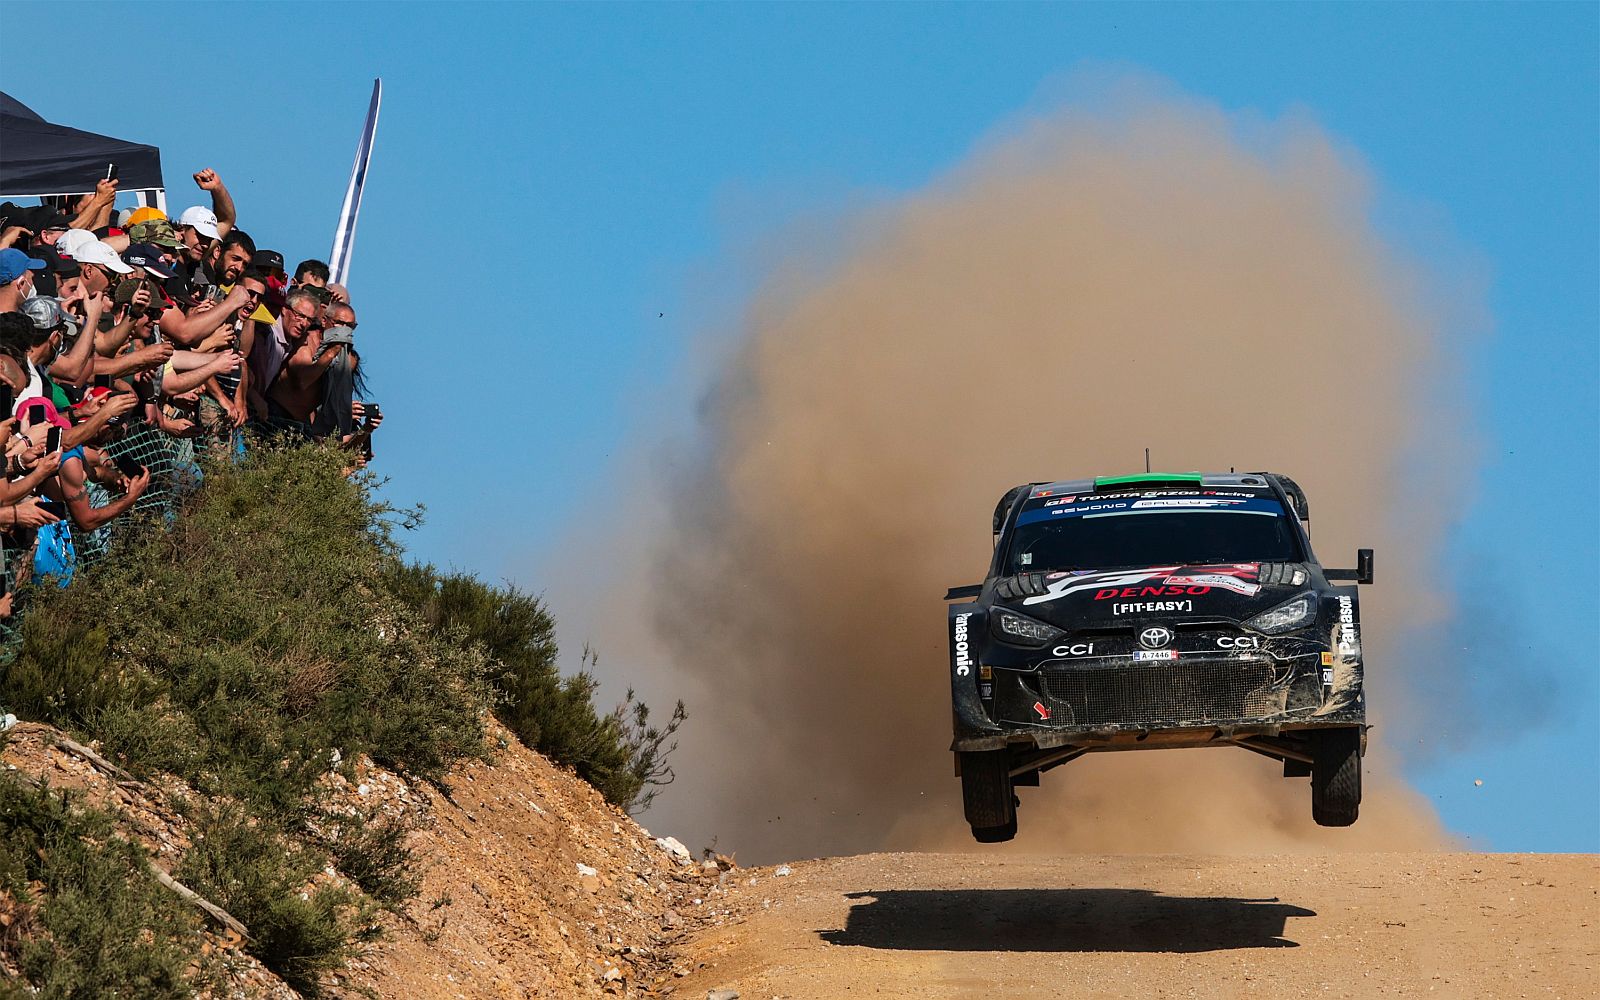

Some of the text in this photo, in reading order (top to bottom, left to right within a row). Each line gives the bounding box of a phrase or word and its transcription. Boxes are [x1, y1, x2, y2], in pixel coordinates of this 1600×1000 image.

[1079, 492, 1140, 501] TOYOTA
[1051, 503, 1127, 515] BEYOND
[1094, 585, 1212, 601] DENSO
